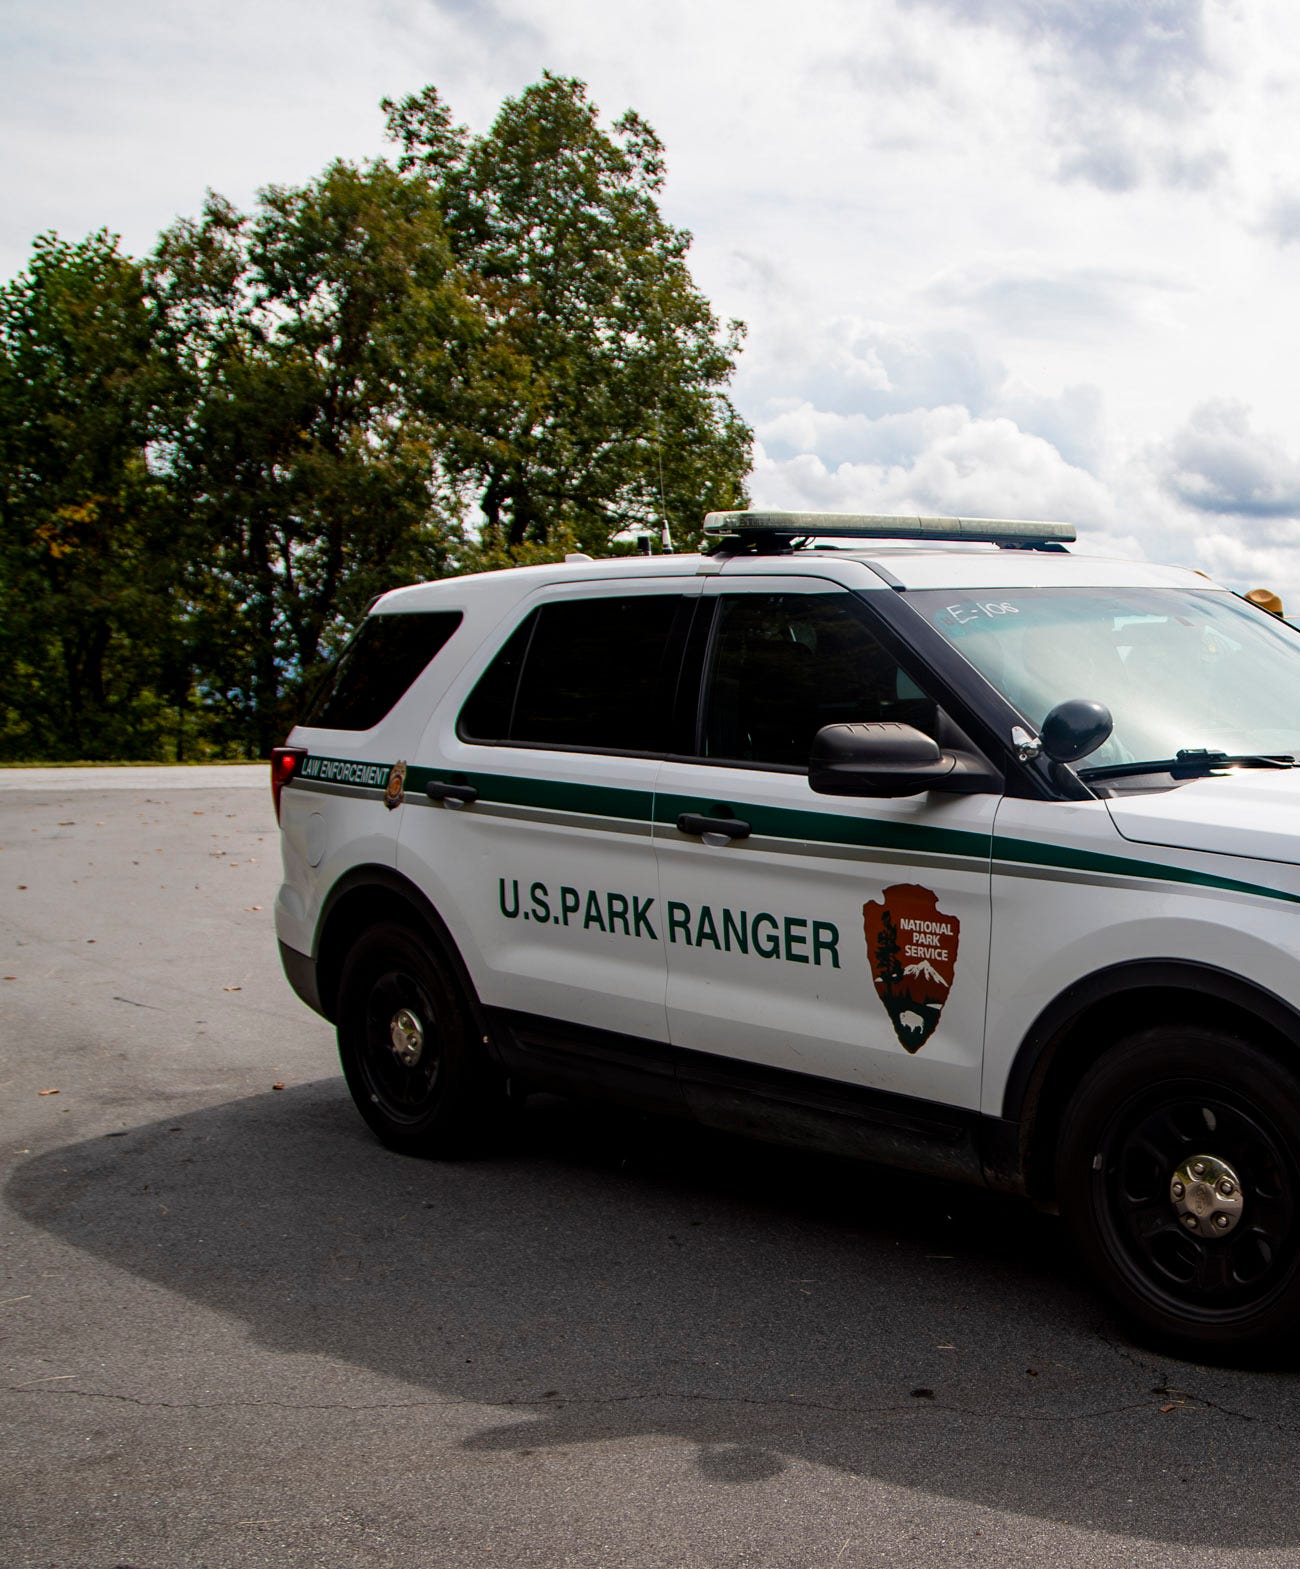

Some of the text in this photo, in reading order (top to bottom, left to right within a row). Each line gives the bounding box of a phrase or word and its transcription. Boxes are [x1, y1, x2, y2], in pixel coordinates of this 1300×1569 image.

[301, 758, 389, 785] LAW ENFORCEMENT
[667, 900, 841, 969] RANGER
[900, 918, 954, 935] NATIONAL
[912, 932, 941, 947] PARK
[904, 945, 949, 961] SERVICE
